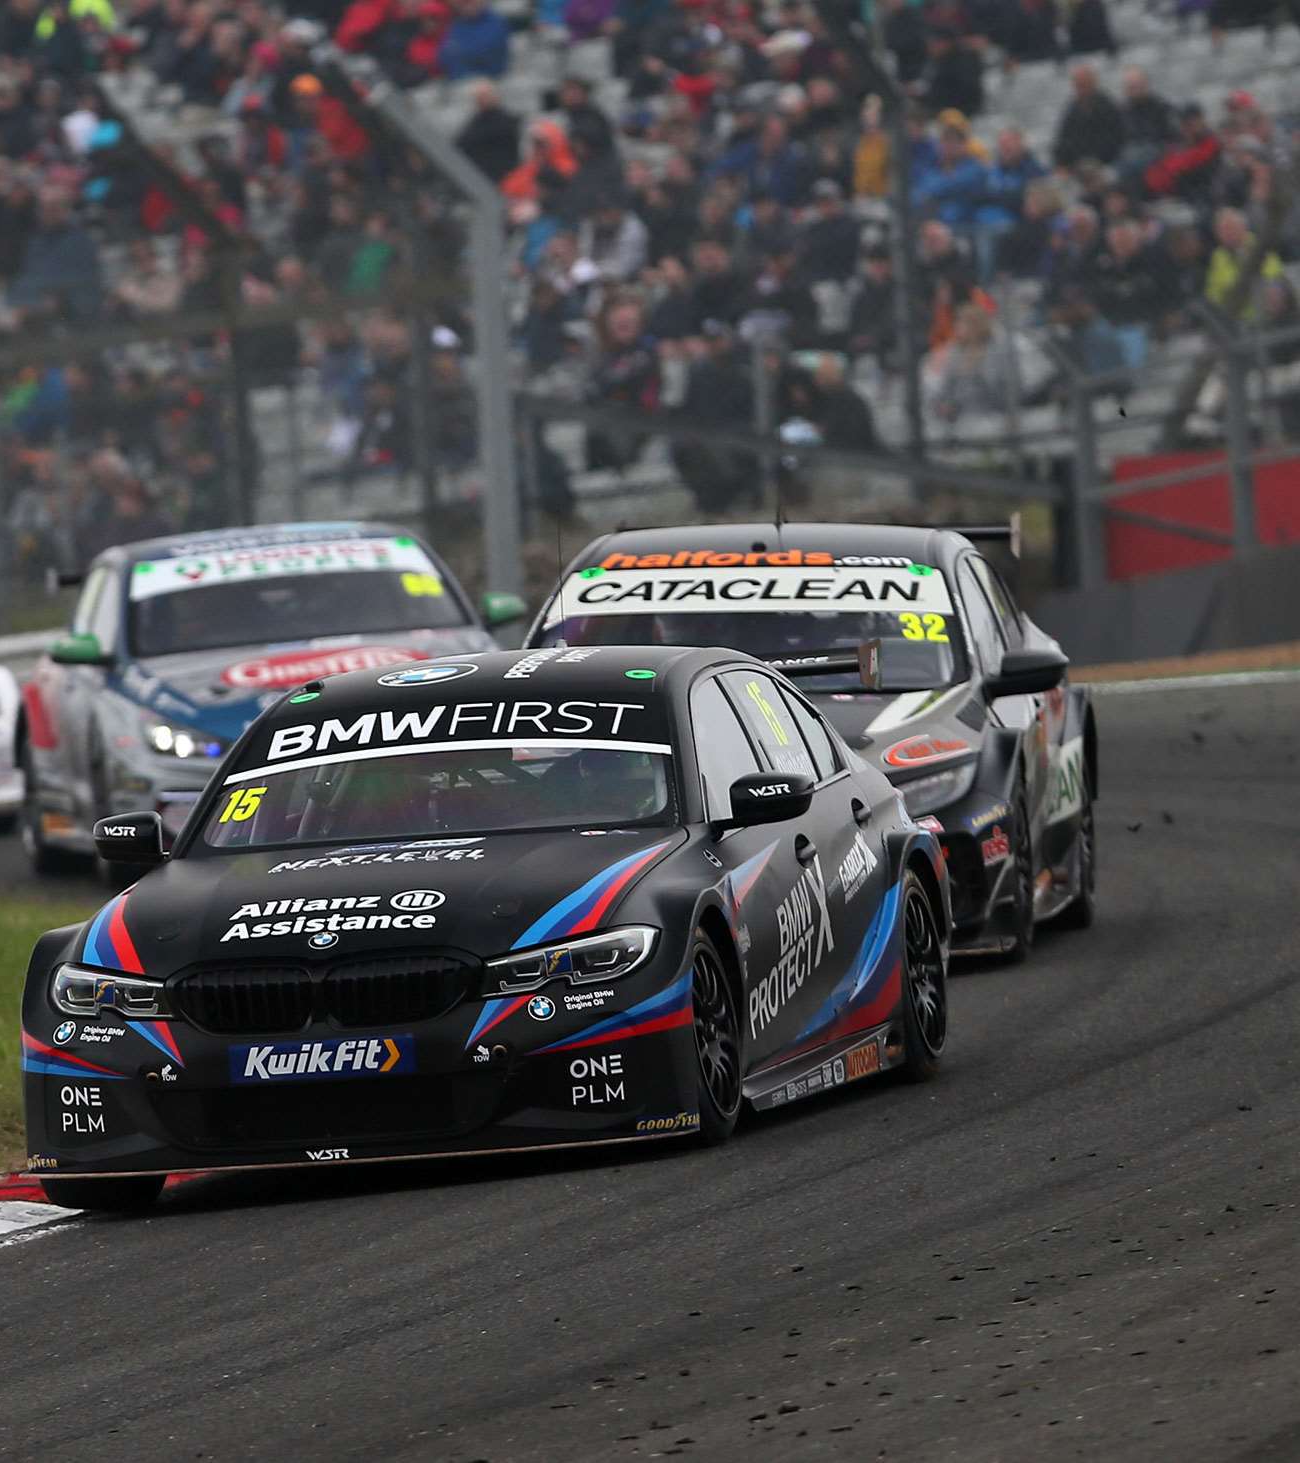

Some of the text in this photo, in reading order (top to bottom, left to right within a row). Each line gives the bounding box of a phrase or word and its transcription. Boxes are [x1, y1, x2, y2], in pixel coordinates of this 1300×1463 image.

[602, 550, 913, 569] halfords.com
[577, 577, 921, 604] CATACLEAN
[899, 613, 950, 643] 32
[748, 783, 792, 797] WSR
[219, 786, 268, 823] 15
[104, 826, 136, 837] WSR
[228, 895, 382, 921] Allianz
[776, 874, 812, 956] BMW
[219, 913, 437, 942] Assistance
[750, 925, 815, 1040] PROTECT
[564, 989, 615, 1003] Original BMW
[566, 998, 605, 1010] Engine Oil
[473, 1054, 491, 1064] TOW
[569, 1054, 624, 1079] ONE
[61, 1086, 103, 1106] ONE
[572, 1081, 626, 1106] PLM
[62, 1112, 106, 1133] PLM
[306, 1148, 350, 1161] WSR
